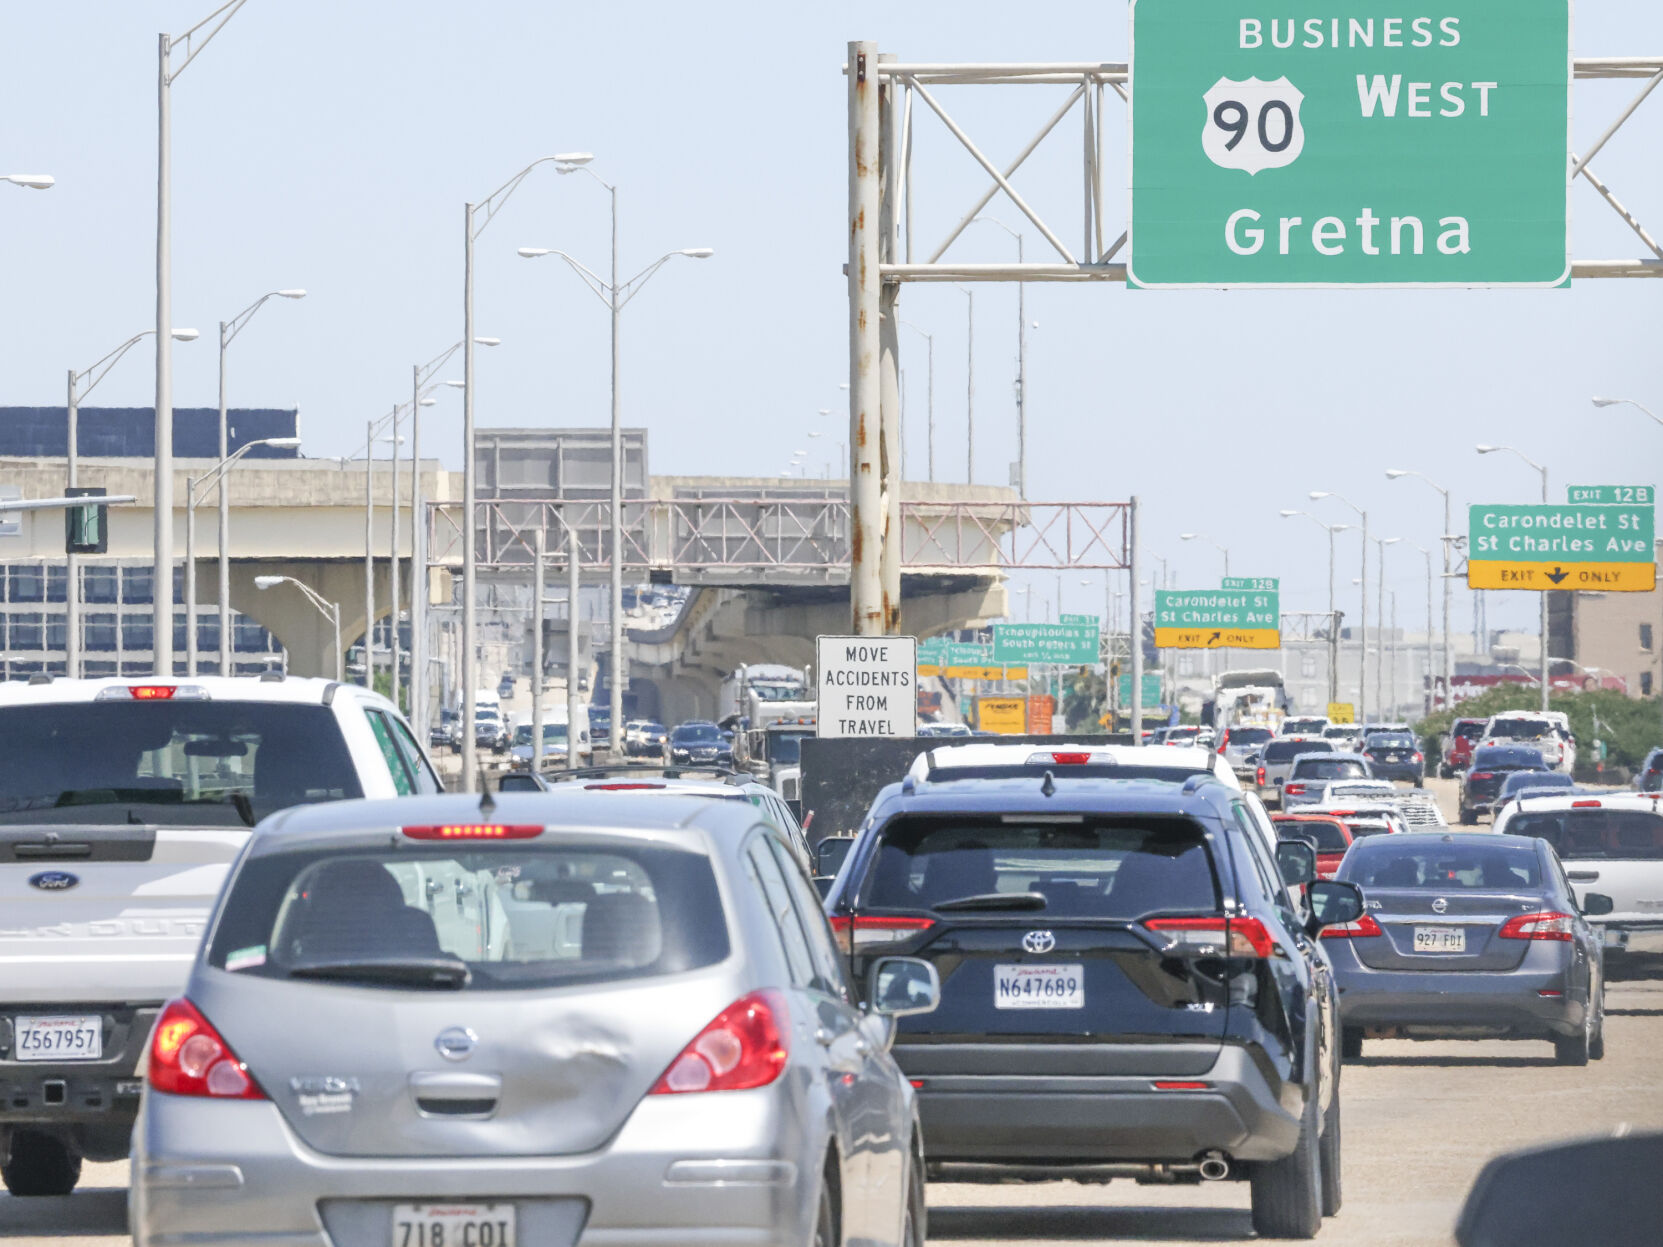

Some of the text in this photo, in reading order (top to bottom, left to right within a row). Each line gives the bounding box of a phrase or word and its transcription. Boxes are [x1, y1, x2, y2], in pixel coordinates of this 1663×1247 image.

[1238, 17, 1461, 48] BUSINESS
[1356, 74, 1498, 118] WEST
[1212, 99, 1294, 153] 90
[1224, 207, 1472, 256] Gretna
[1573, 488, 1648, 502] EXIT 12B
[1483, 512, 1640, 530] Carondelet St
[1478, 535, 1646, 552] St Charles Ave
[1224, 579, 1245, 588] EXIT
[1501, 569, 1621, 582] EXIT ONLY
[1166, 595, 1268, 607] Carondelet St
[1161, 611, 1273, 623] St Charles Ave
[1002, 638, 1035, 648] South
[1178, 634, 1255, 643] EXIT ONLY
[846, 646, 888, 662] MOVE
[826, 670, 909, 686] ACCIDENTS
[846, 694, 888, 711] FROM
[838, 719, 895, 735] TRAVEL
[1417, 933, 1437, 946] 927
[1000, 978, 1077, 997] N647689
[21, 1029, 95, 1049] Z567957
[398, 1221, 444, 1247] 718
